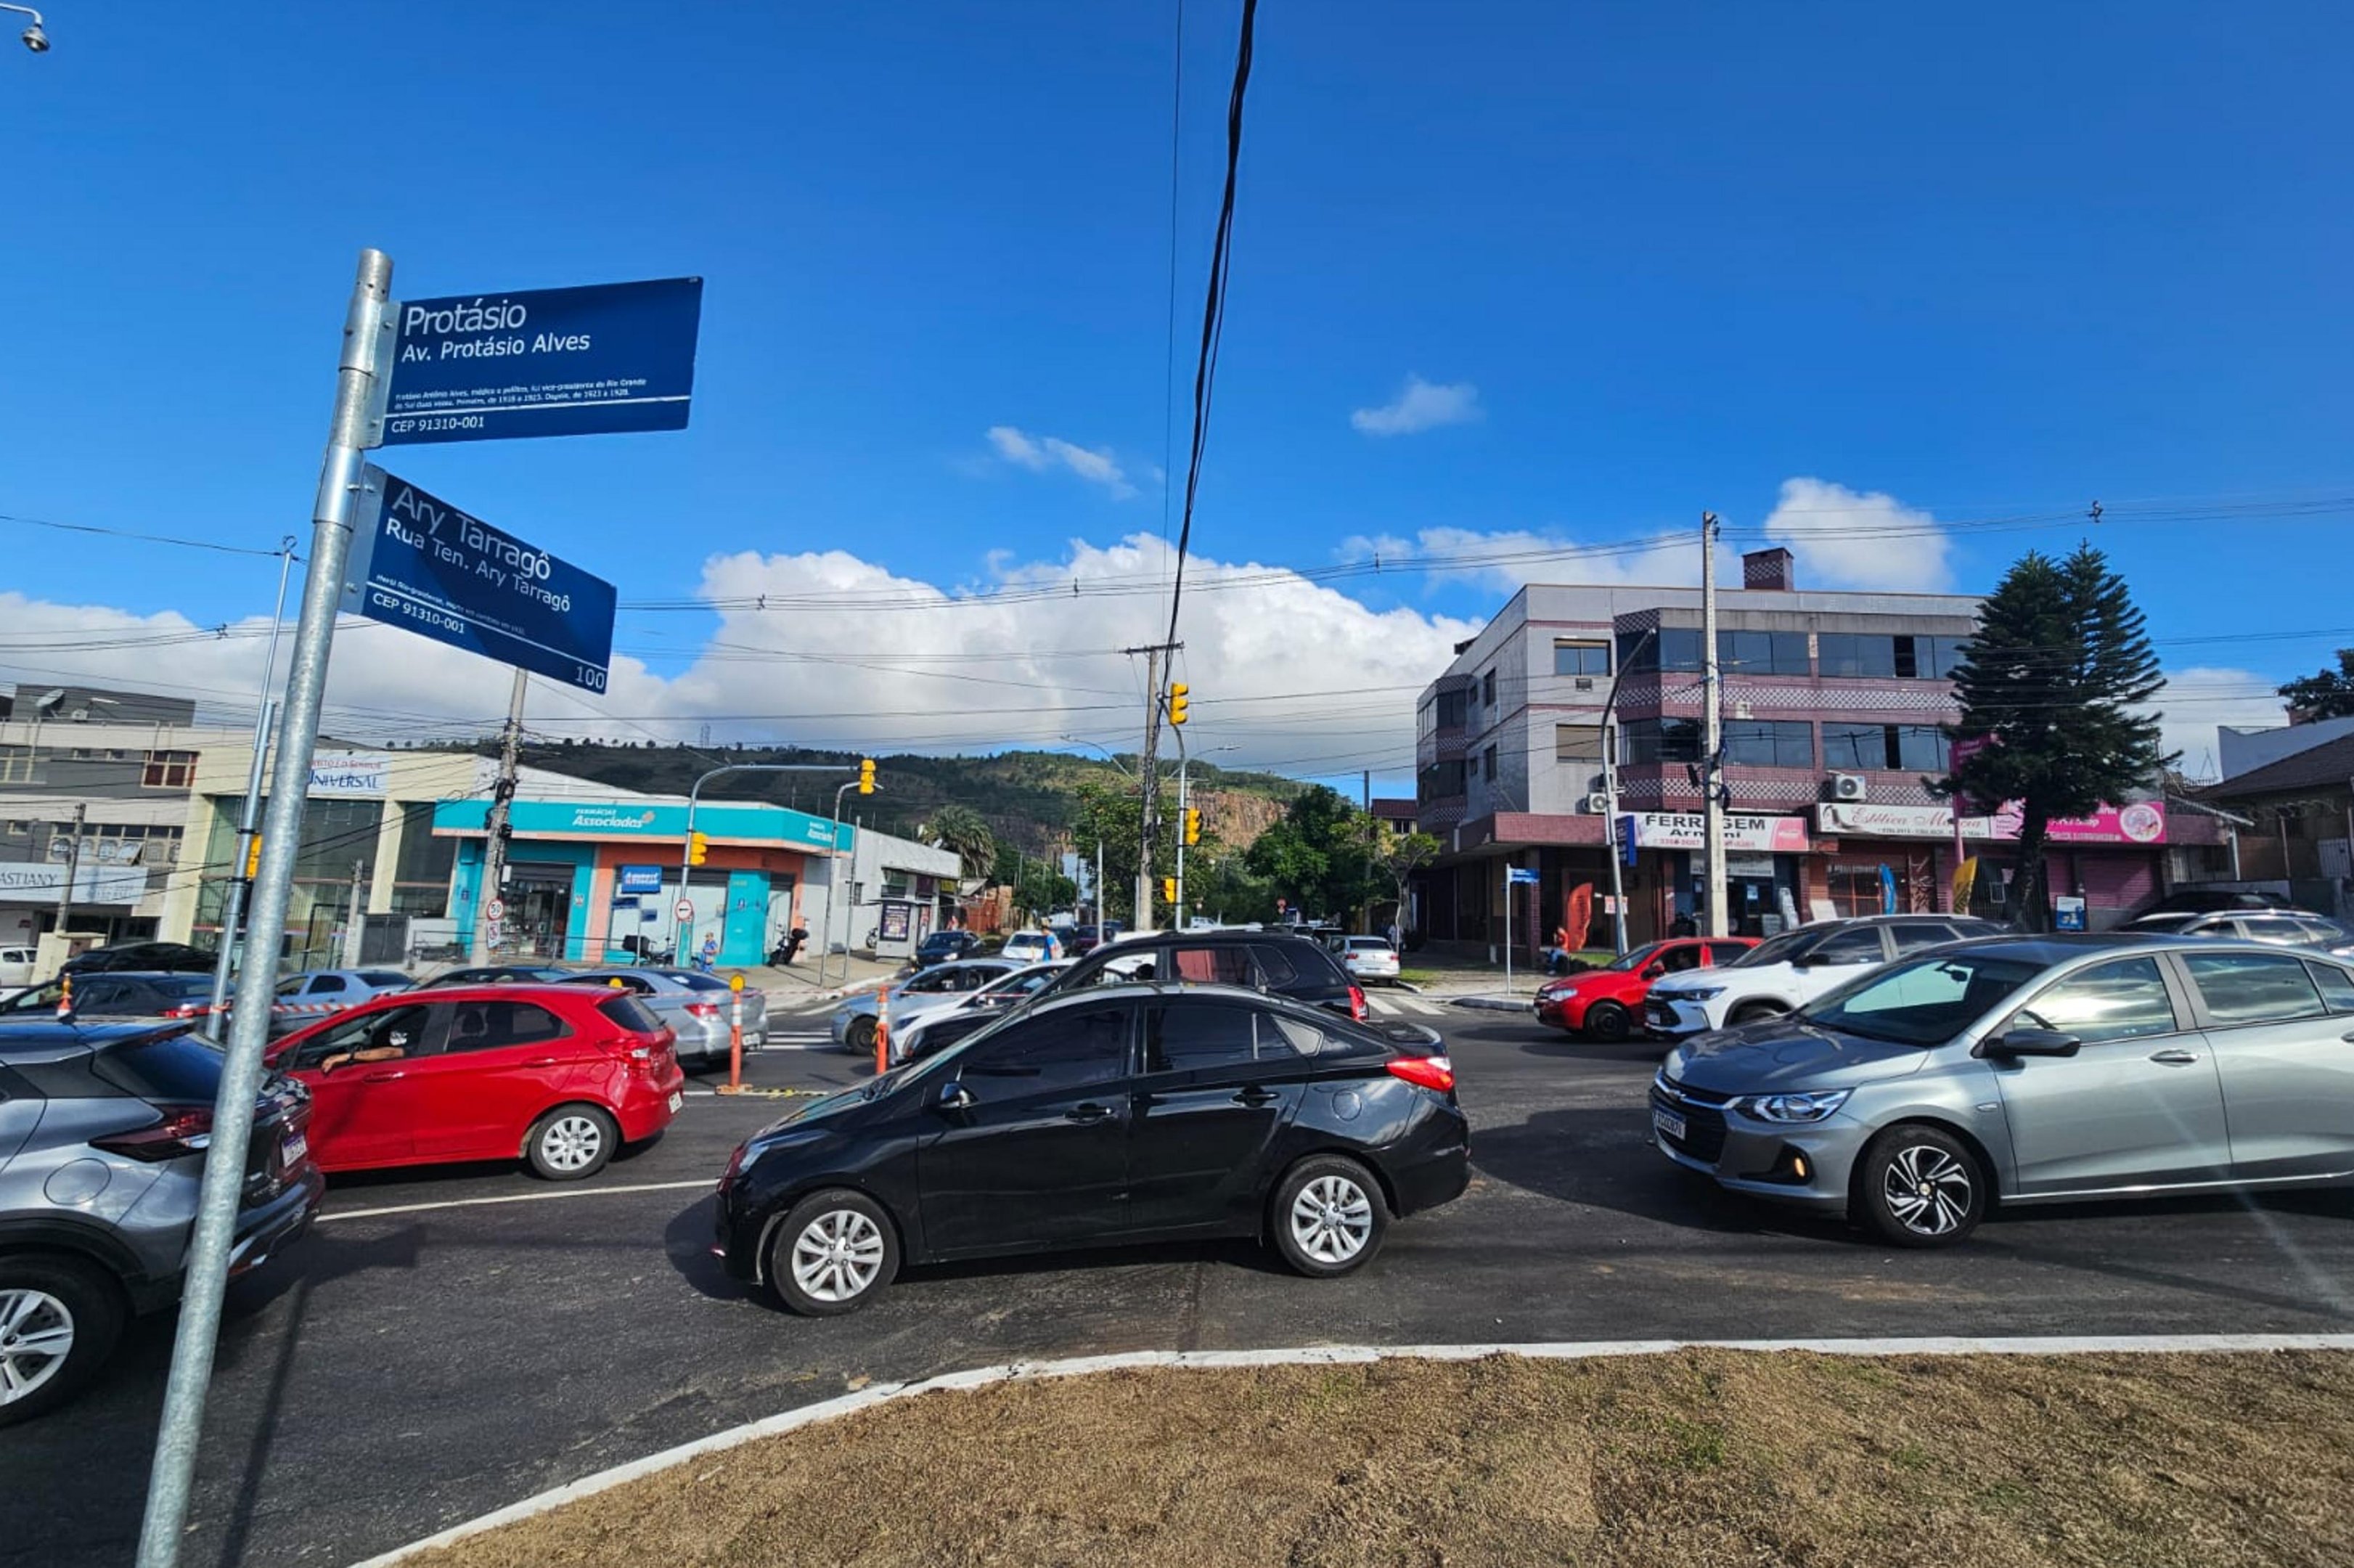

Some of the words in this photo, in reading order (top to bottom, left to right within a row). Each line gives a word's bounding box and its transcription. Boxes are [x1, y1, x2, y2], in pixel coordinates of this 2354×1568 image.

[404, 299, 527, 335] Protásio
[401, 344, 430, 362] Av.
[441, 336, 524, 360] Protásio
[531, 332, 591, 352] Alves
[391, 420, 415, 433] CEP
[419, 416, 484, 431] 91310-001
[392, 486, 446, 536] Ary
[456, 513, 550, 581] Tarragô
[385, 518, 425, 550] Rua
[432, 538, 469, 571] Ten.
[475, 560, 506, 588] Ary
[512, 576, 571, 613] Tarragô
[373, 592, 399, 609] CEP
[403, 603, 465, 634] 91310-001
[575, 665, 605, 690] 100
[1645, 814, 1765, 831] FERRGEM
[1670, 828, 1741, 838] Armni
